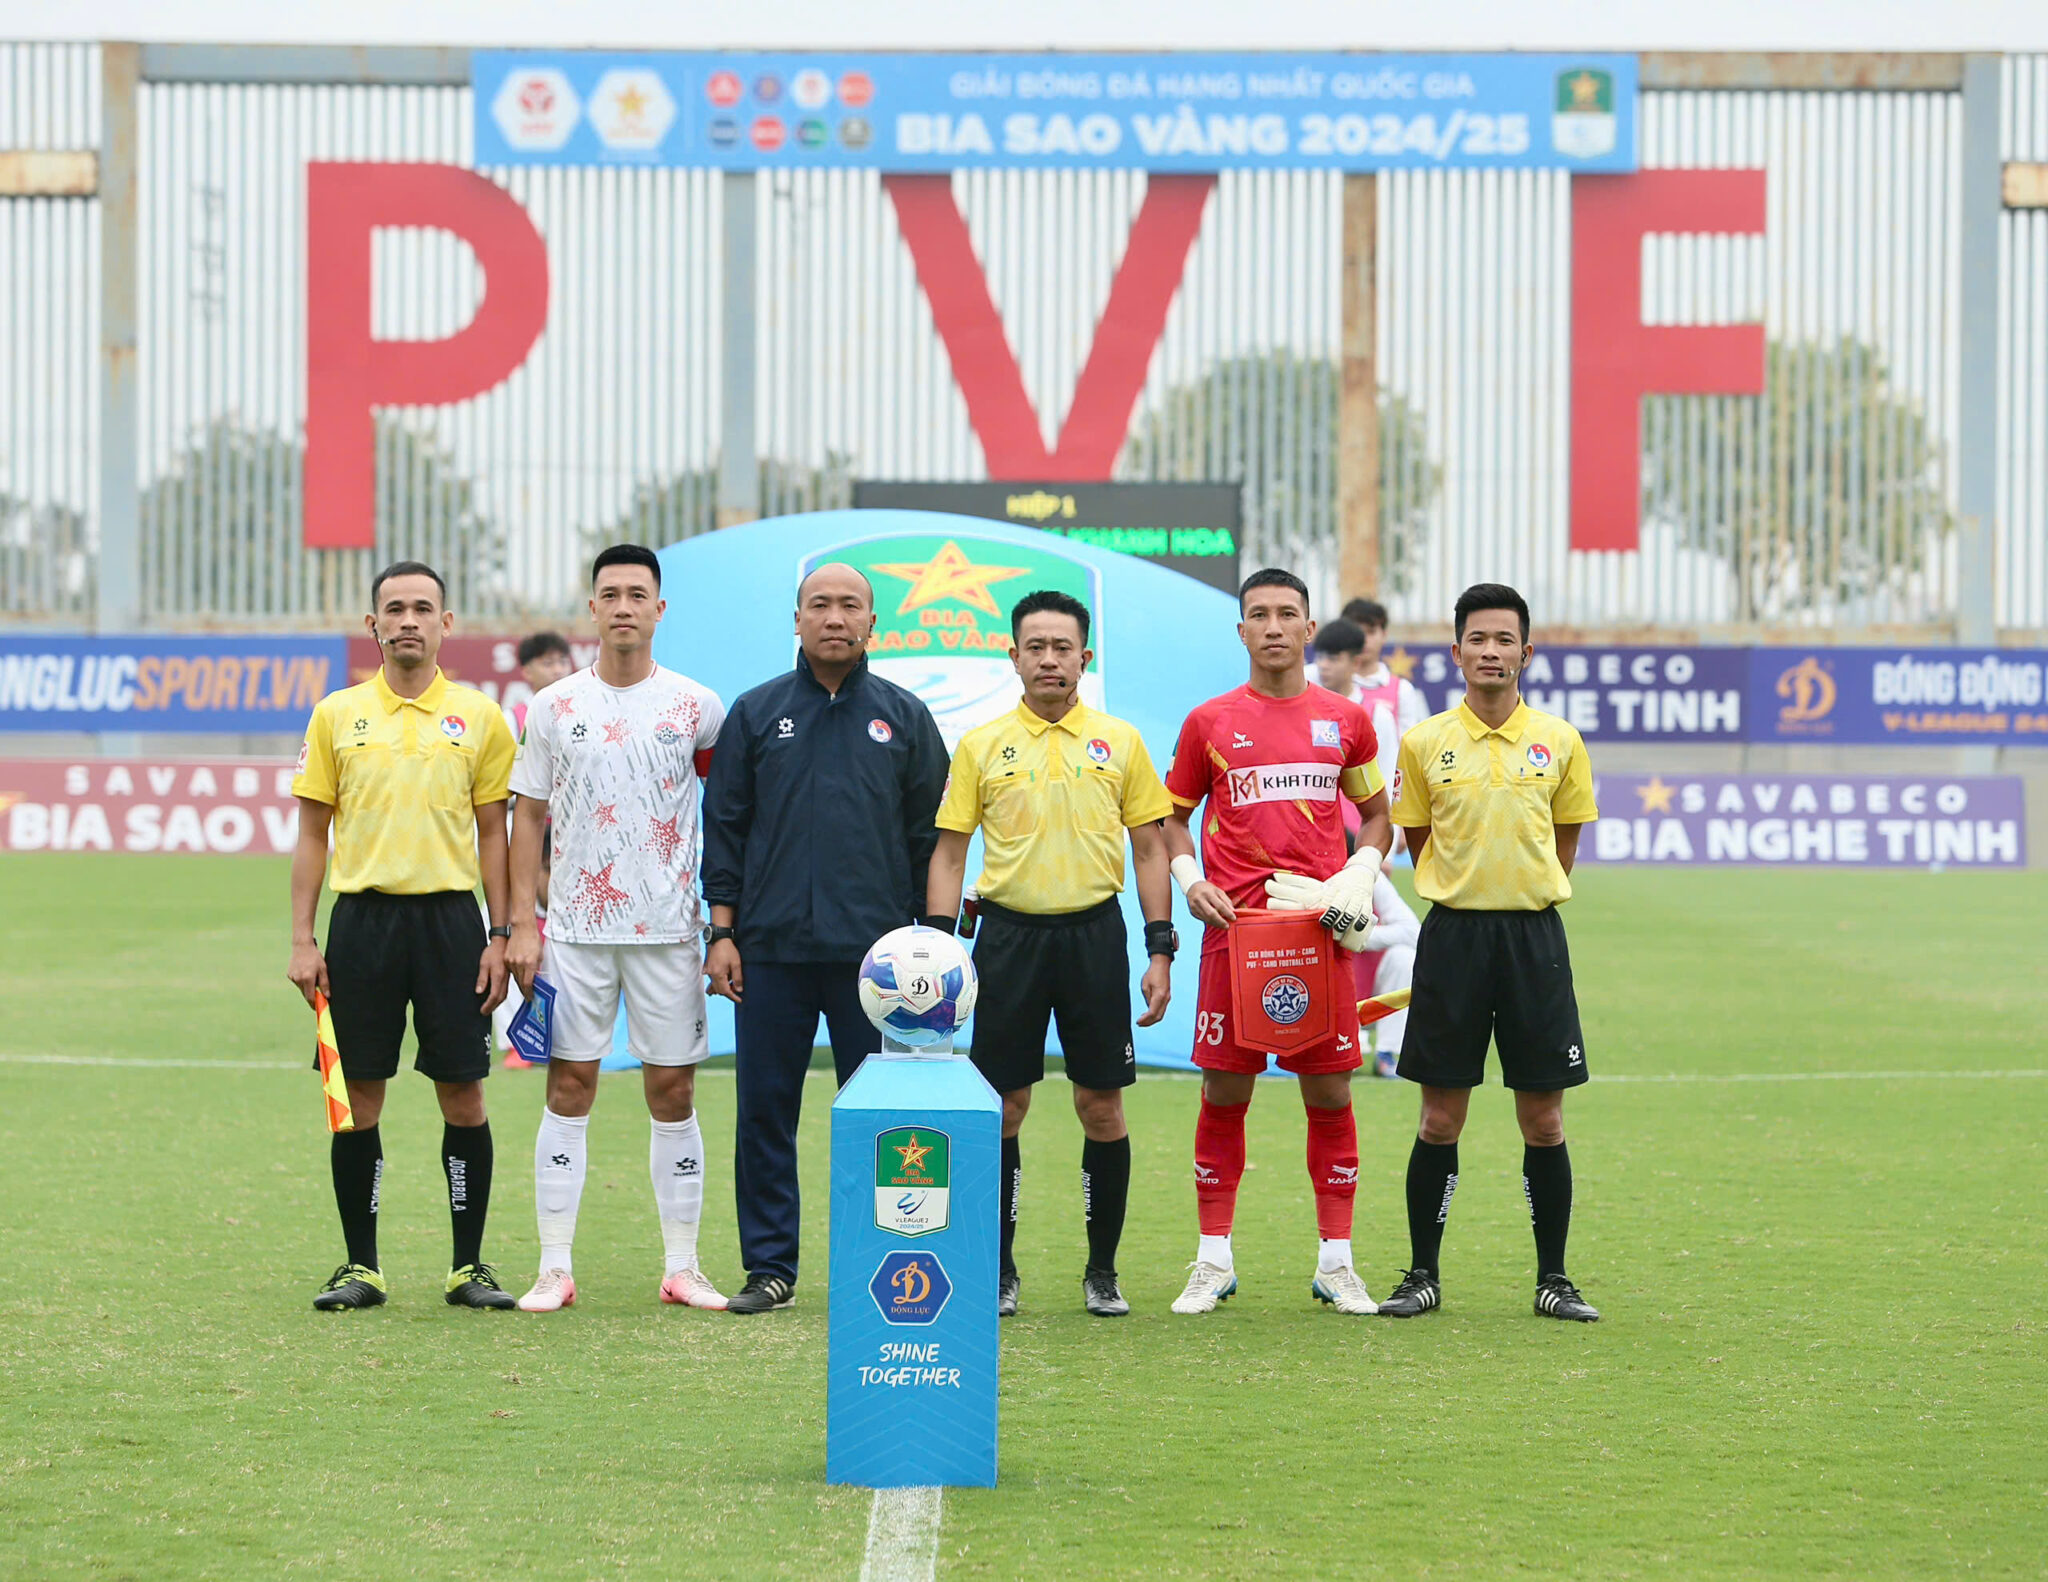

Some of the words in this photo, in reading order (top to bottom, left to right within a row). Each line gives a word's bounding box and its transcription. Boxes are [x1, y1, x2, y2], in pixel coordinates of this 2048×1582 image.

[1423, 72, 1475, 98] GIA
[897, 112, 994, 155] BIA
[1004, 112, 1123, 155] SAO
[1131, 102, 1289, 155] VÀNG
[1297, 110, 1531, 160] 2024/25
[919, 609, 977, 628] BIA
[938, 626, 1011, 651] VÀN
[0, 654, 330, 712] NGLUCSPORT.VN
[1423, 652, 1696, 685] SABECO
[1873, 654, 1956, 705] BÓNG
[1609, 689, 1741, 733] TINH
[1681, 783, 1968, 815] SAVABECO
[9, 802, 114, 851] BIA
[124, 804, 256, 853] SAO
[1595, 817, 1695, 862] BIA
[1705, 818, 1869, 862] NGHE
[1876, 819, 2018, 863] TINH
[1196, 1010, 1225, 1046] 93
[449, 1156, 467, 1212] JOGARBOLA
[879, 1342, 940, 1363] SHINE
[858, 1366, 961, 1389] TOGETHER
